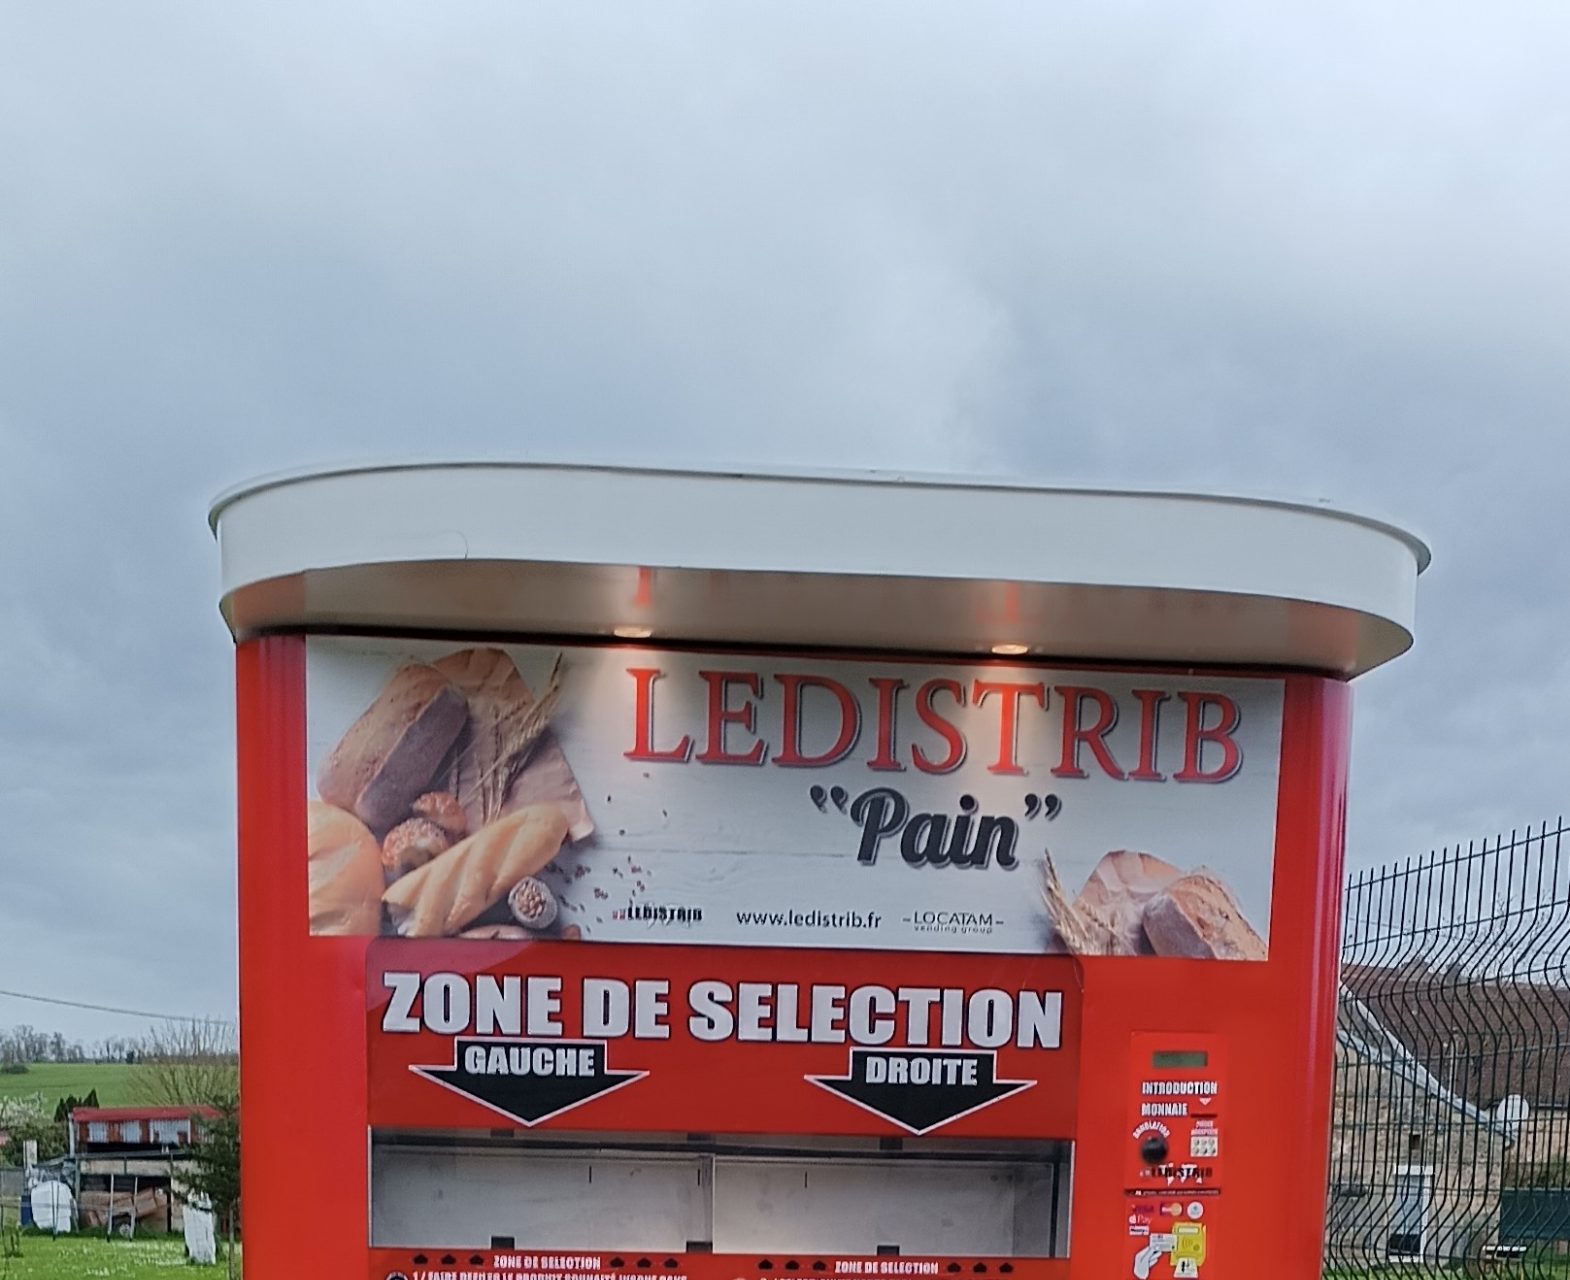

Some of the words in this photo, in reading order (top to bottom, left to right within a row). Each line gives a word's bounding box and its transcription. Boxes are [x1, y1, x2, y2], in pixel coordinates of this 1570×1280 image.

[623, 668, 1244, 783] LEDISTRIB
[736, 909, 882, 929] www.ledistrib.fr
[961, 926, 993, 936] group
[382, 971, 564, 1038] ZONE
[582, 979, 671, 1040] DE
[688, 981, 1063, 1049] SELECTION
[464, 1046, 596, 1077] GAUCHE
[865, 1056, 978, 1087] DROITE
[1142, 1081, 1218, 1095] INTRODUCTION
[1141, 1102, 1188, 1117] MONNAIE
[493, 1255, 522, 1269] ZONE
[524, 1256, 539, 1269] DE
[541, 1256, 601, 1270] SELECTION
[835, 1261, 862, 1273] ZONE
[864, 1262, 878, 1274] DE
[880, 1262, 939, 1275] SELECTION
